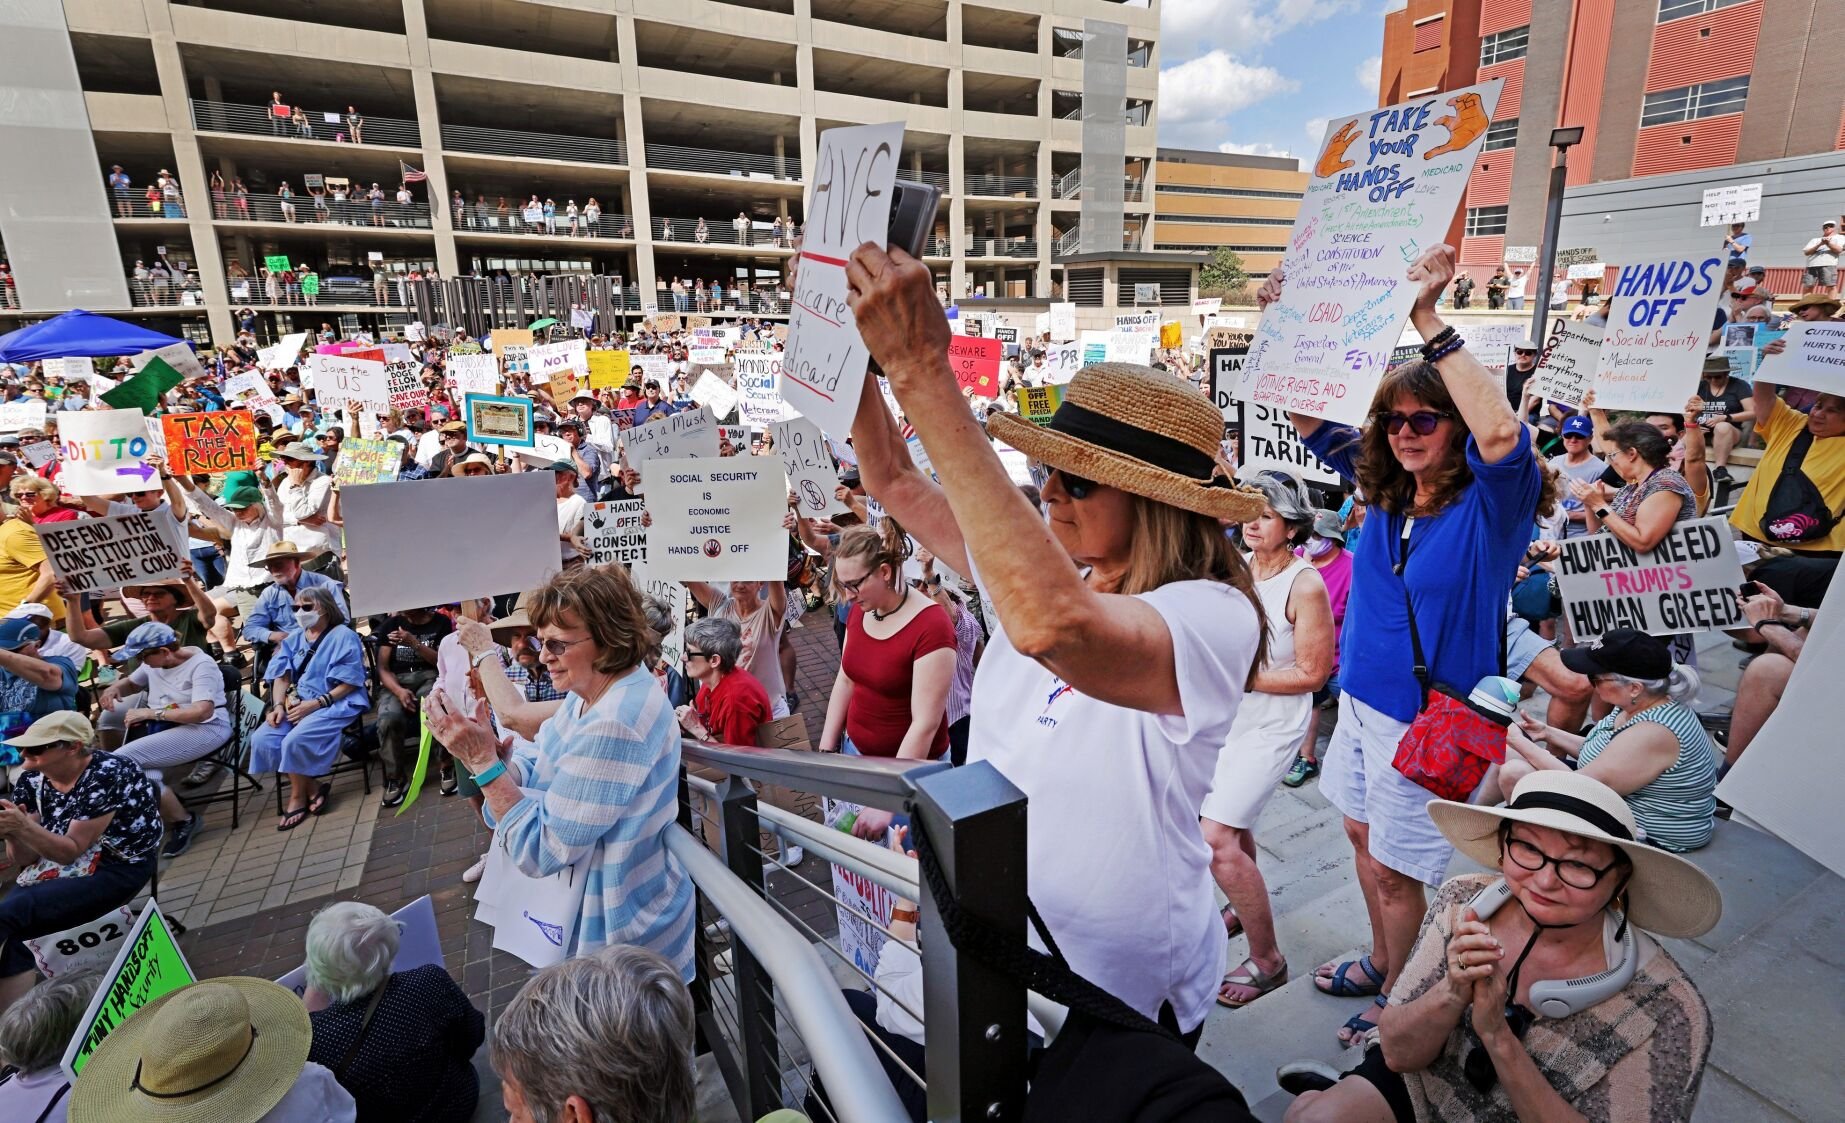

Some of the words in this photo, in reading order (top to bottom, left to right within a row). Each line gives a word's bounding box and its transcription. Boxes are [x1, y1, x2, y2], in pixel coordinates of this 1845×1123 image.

[1369, 100, 1437, 138] TAKE
[1367, 134, 1419, 165] YOUR
[1336, 164, 1400, 192] HANDS
[1421, 163, 1463, 178] MEDICAID
[806, 141, 891, 247] AVE
[1368, 176, 1416, 203] OFF
[1414, 183, 1440, 195] LOVE
[1331, 232, 1373, 244] SCIENCE
[1557, 248, 1580, 257] HANDS
[1615, 258, 1722, 297] HANDS
[794, 267, 846, 325] dicare
[1308, 302, 1343, 323] USAID
[1629, 298, 1686, 327] OFF
[1116, 317, 1141, 325] HANDS
[1143, 316, 1157, 324] OFF
[1228, 332, 1244, 340] YOUR
[1552, 319, 1603, 347] Department
[1612, 329, 1648, 346] Social
[1652, 330, 1699, 350] Security
[1213, 338, 1227, 347] YOU
[1803, 340, 1837, 351] HURTS
[949, 344, 986, 357] BEWARE
[1393, 348, 1420, 357] ELIEV
[544, 354, 569, 368] NOT
[784, 335, 852, 392] edicaid
[962, 361, 974, 369] OF
[1542, 348, 1576, 369] Gutting
[1606, 352, 1654, 368] Medicare
[1807, 354, 1845, 366] VULNER
[320, 358, 348, 374] Save
[349, 365, 371, 376] the
[385, 364, 395, 372] AY
[407, 361, 417, 369] TO
[391, 369, 414, 379] DOGE
[739, 359, 769, 374] HANDS
[771, 360, 783, 374] OF
[337, 376, 361, 392] US
[387, 376, 417, 387] FELON
[739, 374, 774, 388] Social
[955, 371, 977, 383] DOG
[1602, 370, 1648, 384] Medicaid
[388, 382, 422, 393] TRUMP!!
[1256, 374, 1287, 392] VOTING
[1287, 377, 1320, 396] RIGHTS
[1322, 381, 1347, 399] AND
[1554, 380, 1583, 395] making
[318, 393, 388, 413] Consttion
[390, 393, 410, 403] SAVE
[409, 390, 426, 398] OUR
[746, 388, 784, 403] Security
[741, 402, 779, 415] Veterans
[1029, 400, 1050, 409] FREE
[173, 415, 240, 437] TAX
[627, 429, 654, 447] He's
[660, 427, 668, 435] a
[672, 413, 707, 433] Musk
[1272, 423, 1298, 441] TH
[195, 436, 227, 449] THE
[778, 426, 802, 449] No
[655, 441, 671, 455] to
[670, 474, 703, 484] SOCIAL
[710, 471, 758, 482] SECURITY
[703, 492, 712, 501] IS
[610, 501, 645, 513] HANDS
[688, 507, 730, 516] ECONOMIC
[42, 522, 114, 552] DEFEND
[117, 513, 156, 536] THE
[689, 525, 732, 535] JUSTICE
[593, 533, 647, 549] CONSUM
[55, 532, 172, 573] CONSTITUTION,
[586, 547, 647, 564] PROTECT
[668, 546, 699, 555] HANDS
[730, 544, 750, 553] OFF
[1560, 536, 1638, 575] HUMAN
[1653, 524, 1721, 563] NEED
[65, 571, 99, 592] NOT
[103, 563, 137, 583] THE
[141, 552, 178, 574] COUP
[1600, 565, 1693, 597] TRUMPS
[1570, 597, 1648, 637] HUMAN
[1659, 587, 1742, 630] GREED
[56, 923, 124, 956] 802
[130, 953, 162, 1010] Security
[82, 1007, 115, 1057] TINY
